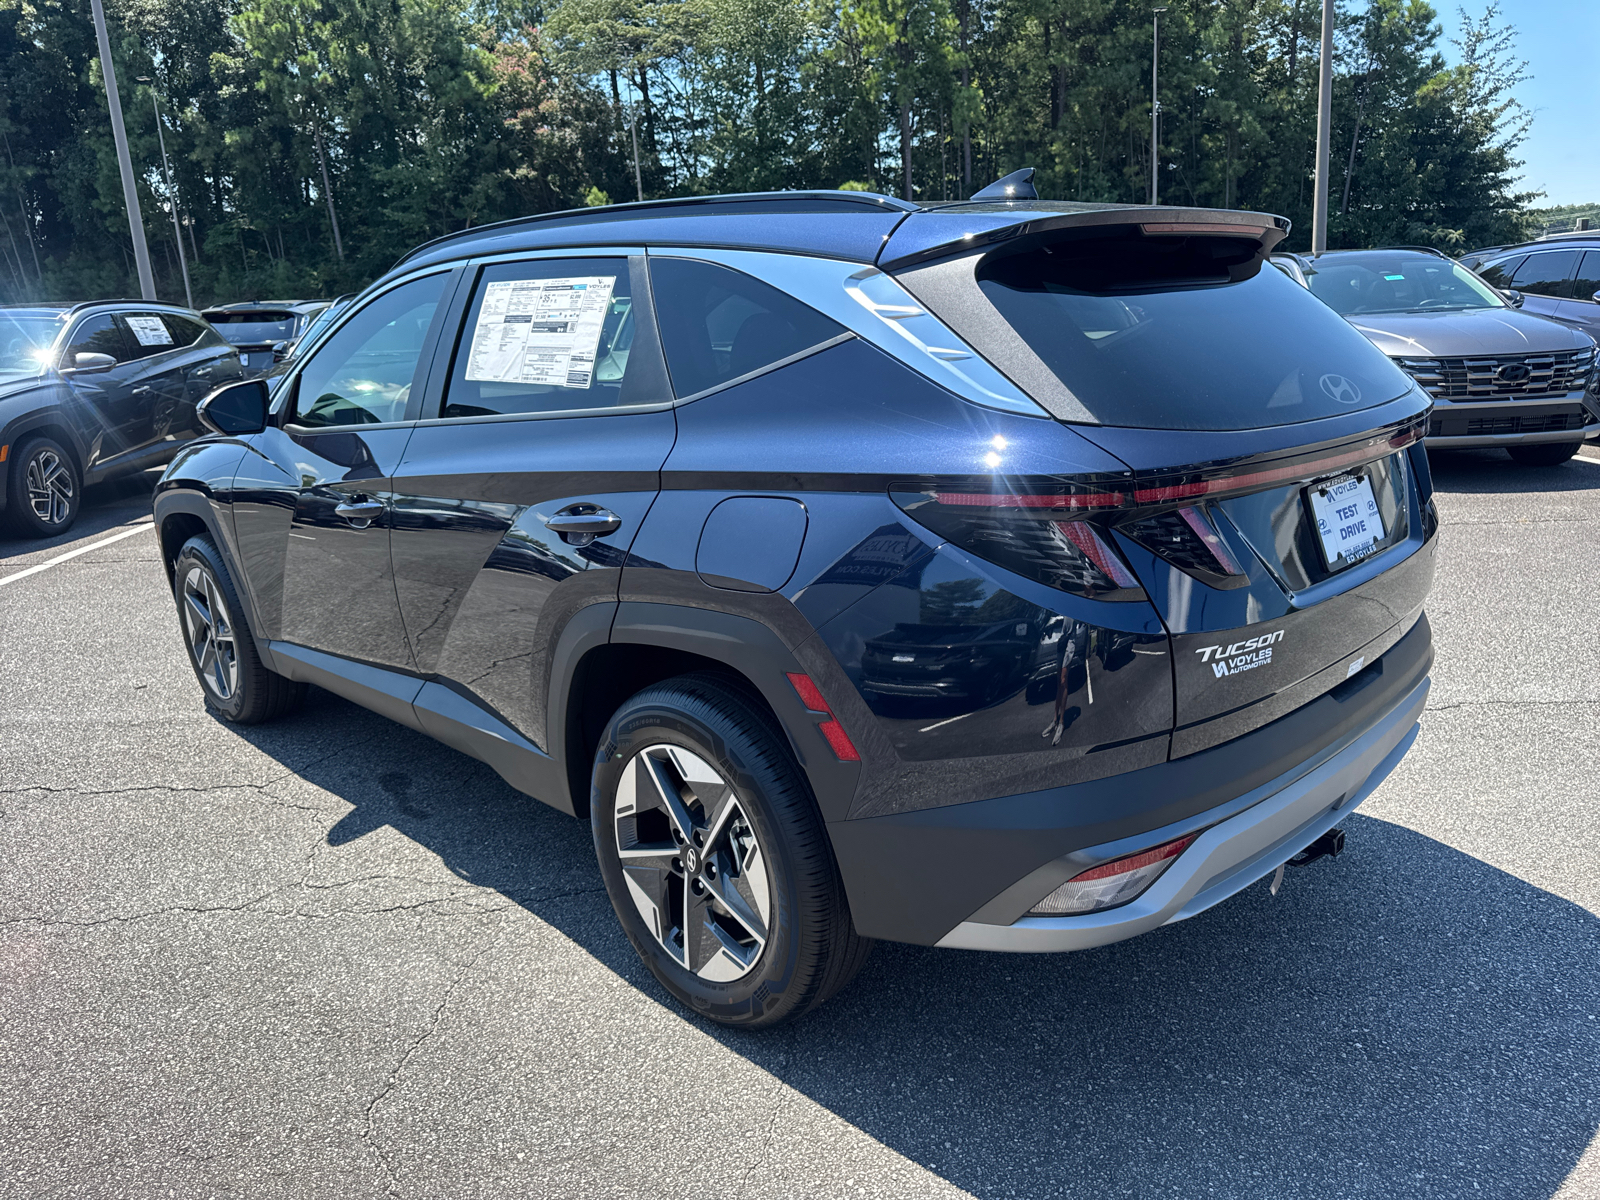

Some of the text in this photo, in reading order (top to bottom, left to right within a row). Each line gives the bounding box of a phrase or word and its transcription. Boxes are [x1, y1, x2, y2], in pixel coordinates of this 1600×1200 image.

[1332, 480, 1358, 496] VOYLES
[1335, 503, 1359, 521] TEST
[1339, 520, 1367, 541] DRIVE
[1346, 544, 1377, 563] ED VOYLES
[1194, 629, 1285, 663] TUCSON
[1228, 647, 1273, 668] VOYLES
[1229, 656, 1272, 675] AUTOMOTIVE
